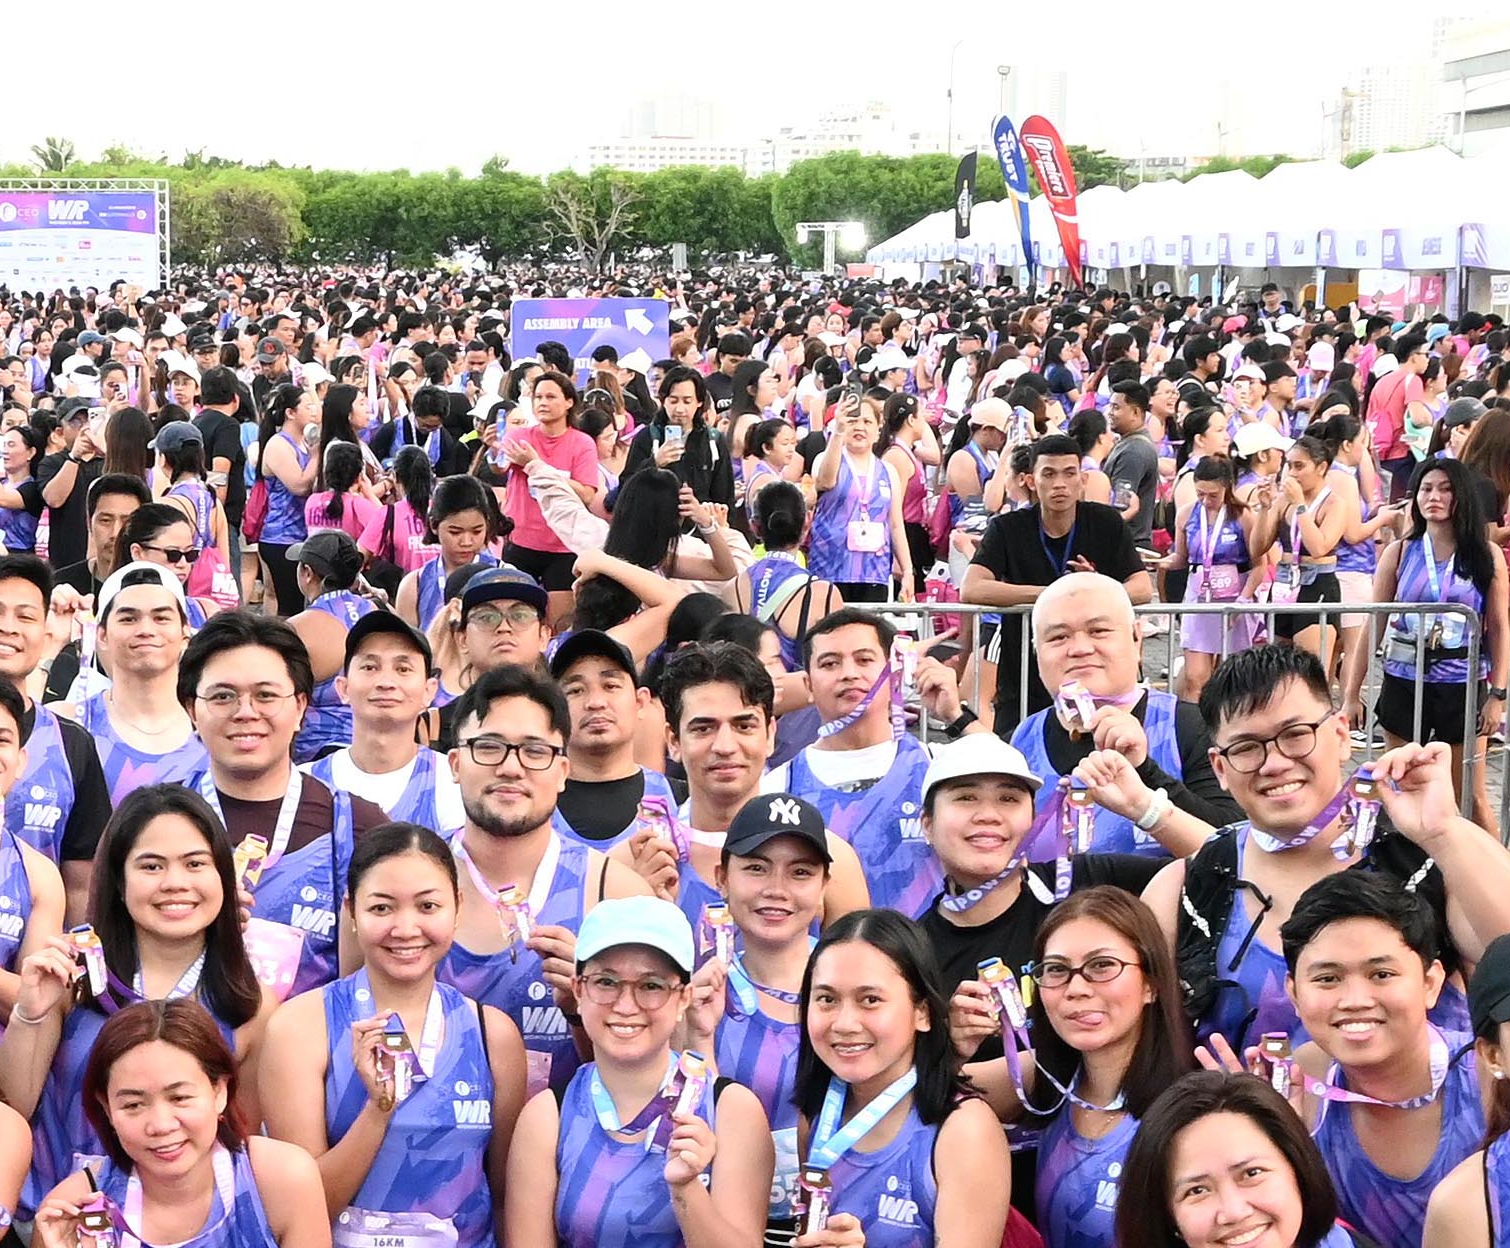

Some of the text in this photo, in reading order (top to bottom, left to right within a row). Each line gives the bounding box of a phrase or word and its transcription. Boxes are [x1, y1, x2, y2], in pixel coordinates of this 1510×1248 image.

[524, 317, 612, 330] ASSEMBLY AREA
[1210, 576, 1233, 590] 589
[24, 803, 61, 828] WR
[292, 903, 336, 936] WR
[452, 1100, 490, 1124] WR
[1096, 1180, 1117, 1206] W
[878, 1194, 919, 1223] WR
[373, 1237, 405, 1248] 16KM
